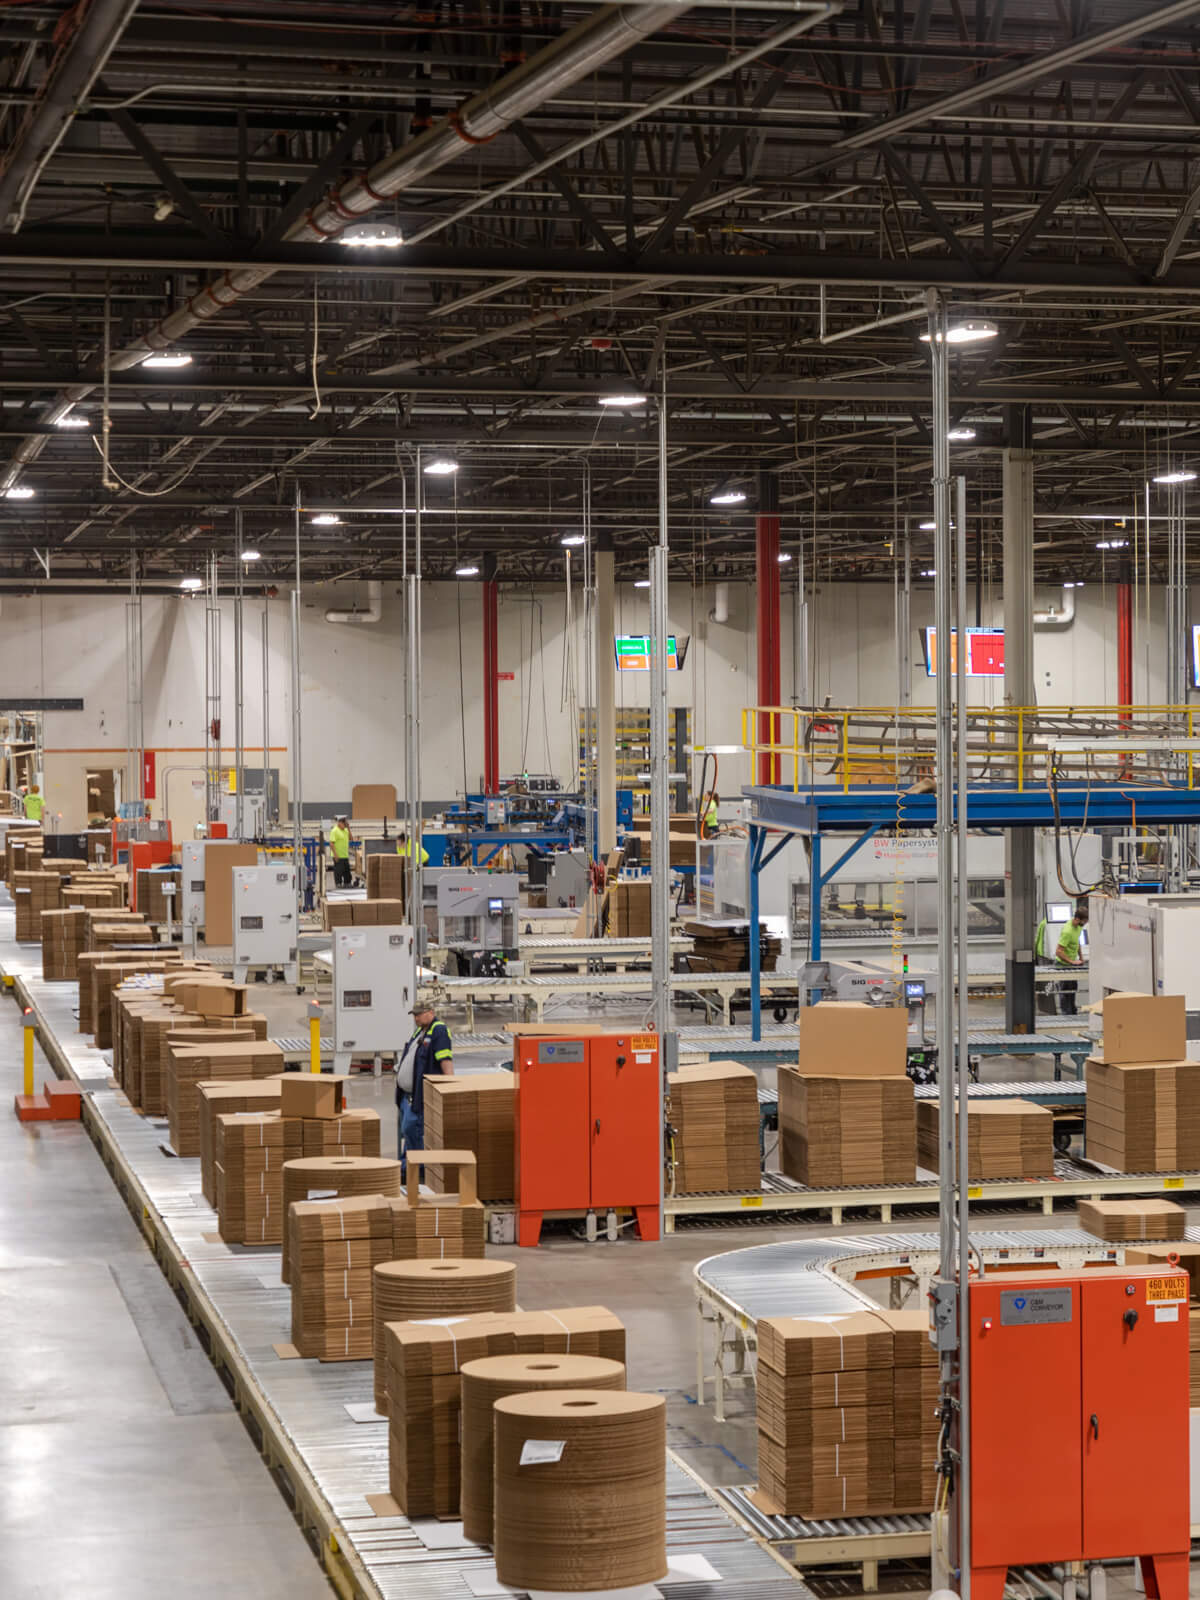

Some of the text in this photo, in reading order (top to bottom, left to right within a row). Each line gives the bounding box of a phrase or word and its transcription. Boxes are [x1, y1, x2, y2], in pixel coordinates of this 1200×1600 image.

[874, 839, 889, 847] BW
[1149, 1278, 1185, 1289] 460 VOLTS
[1149, 1288, 1185, 1300] THREE PHASE
